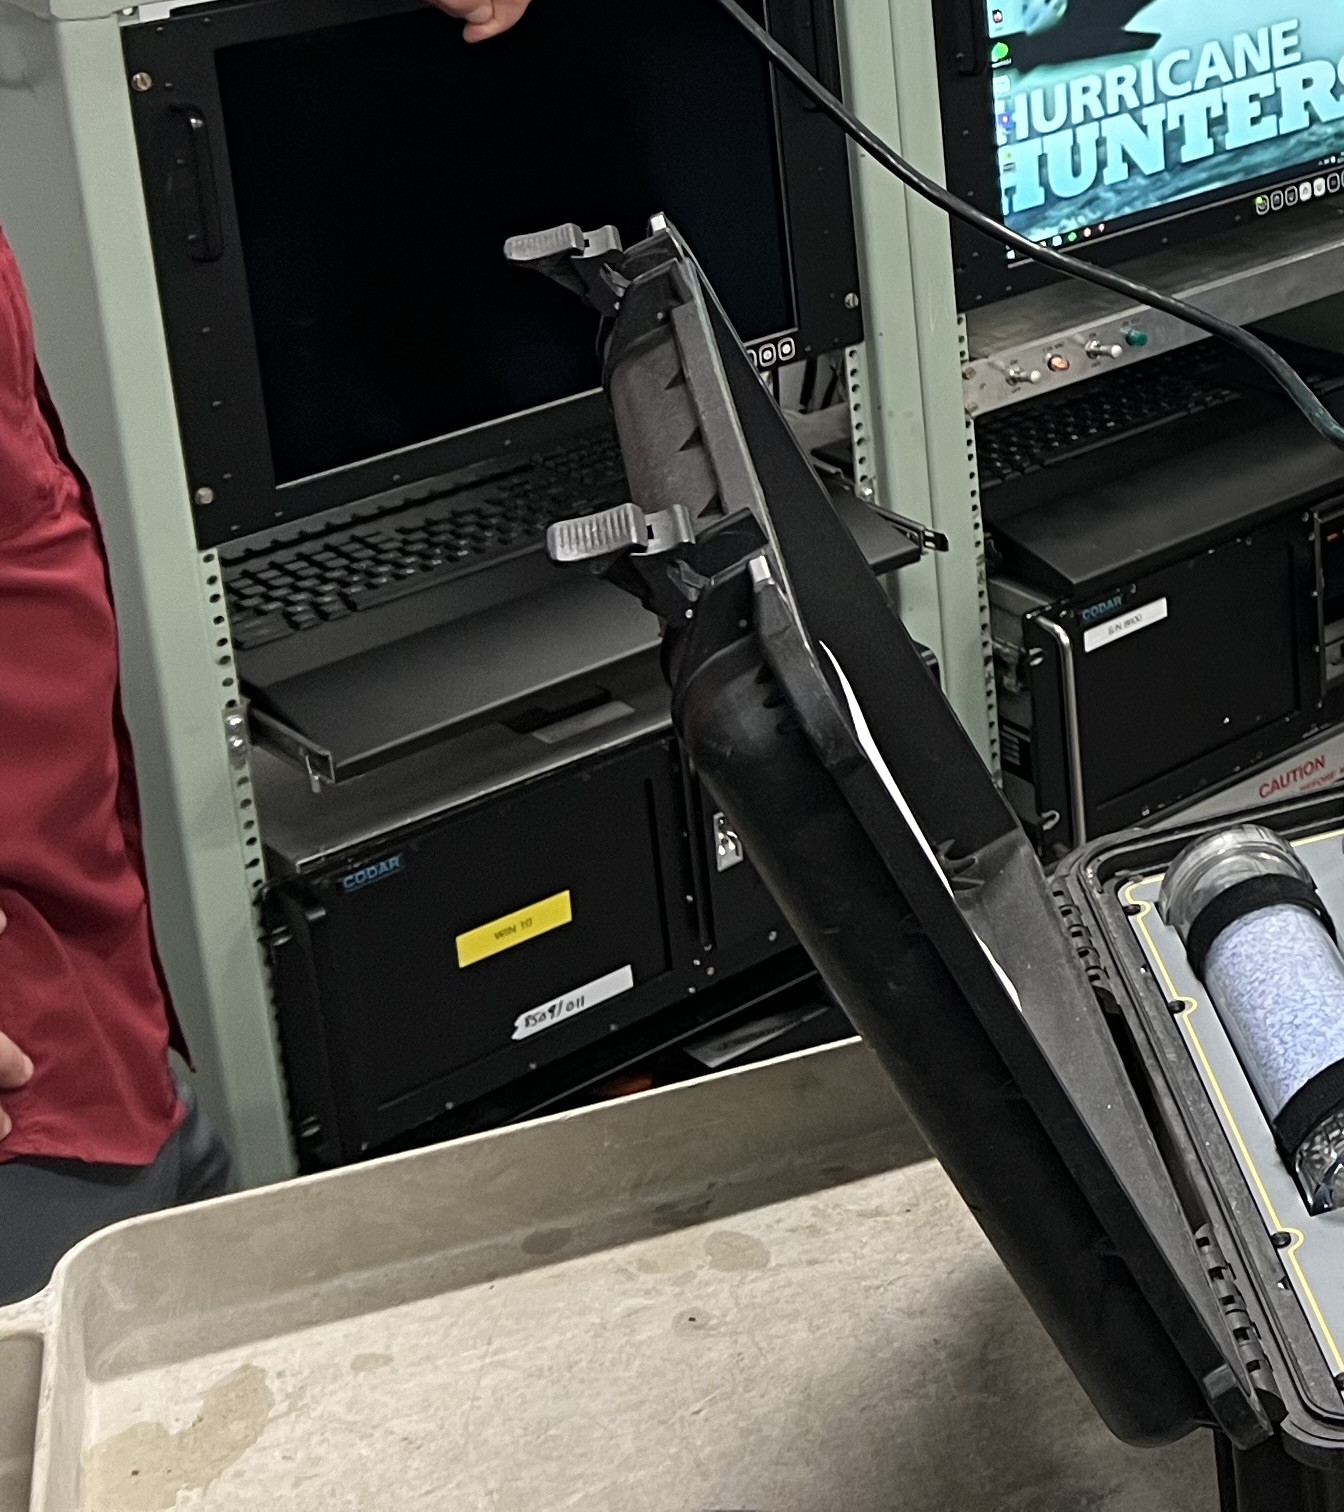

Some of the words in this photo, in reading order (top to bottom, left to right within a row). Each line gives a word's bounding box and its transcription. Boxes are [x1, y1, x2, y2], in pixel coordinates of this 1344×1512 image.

[998, 19, 1301, 145] HURRICANE
[1082, 596, 1123, 620] CODAR
[1258, 755, 1326, 798] CAUTION
[342, 855, 400, 889] CODAR
